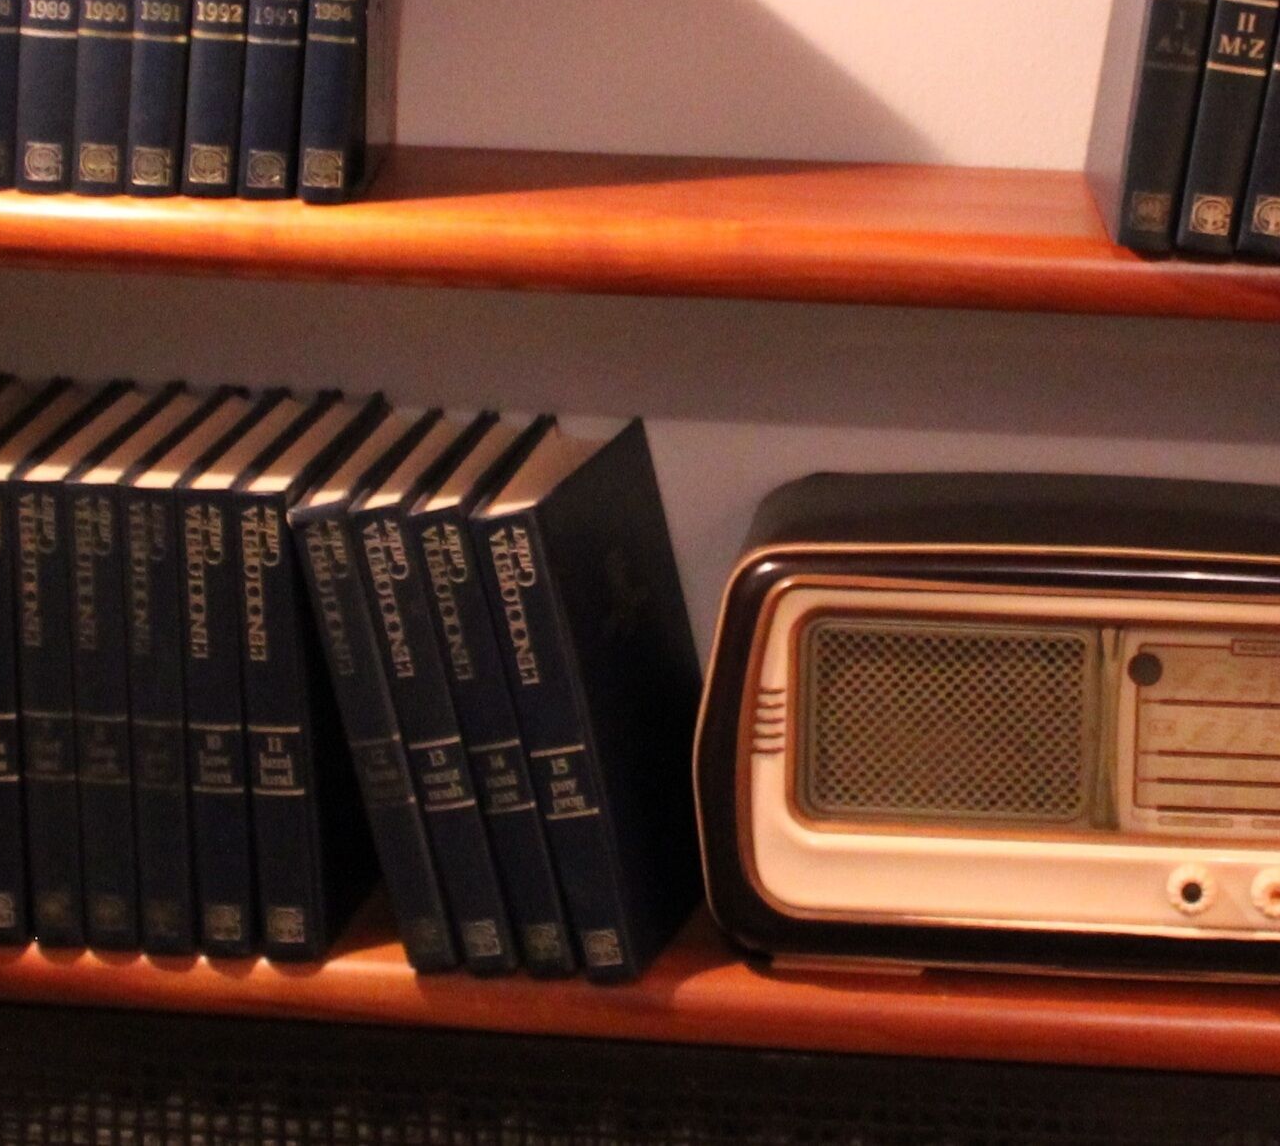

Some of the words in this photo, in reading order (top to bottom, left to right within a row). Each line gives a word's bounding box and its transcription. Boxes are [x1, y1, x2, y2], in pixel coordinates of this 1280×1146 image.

[29, 0, 69, 19] 1989
[85, 0, 126, 22] 1990
[141, 1, 181, 22] 1991
[196, 1, 242, 23] 1992
[315, 2, 353, 21] 1994
[268, 737, 283, 752] 11
[428, 750, 446, 767] 13
[551, 758, 569, 775] 15
